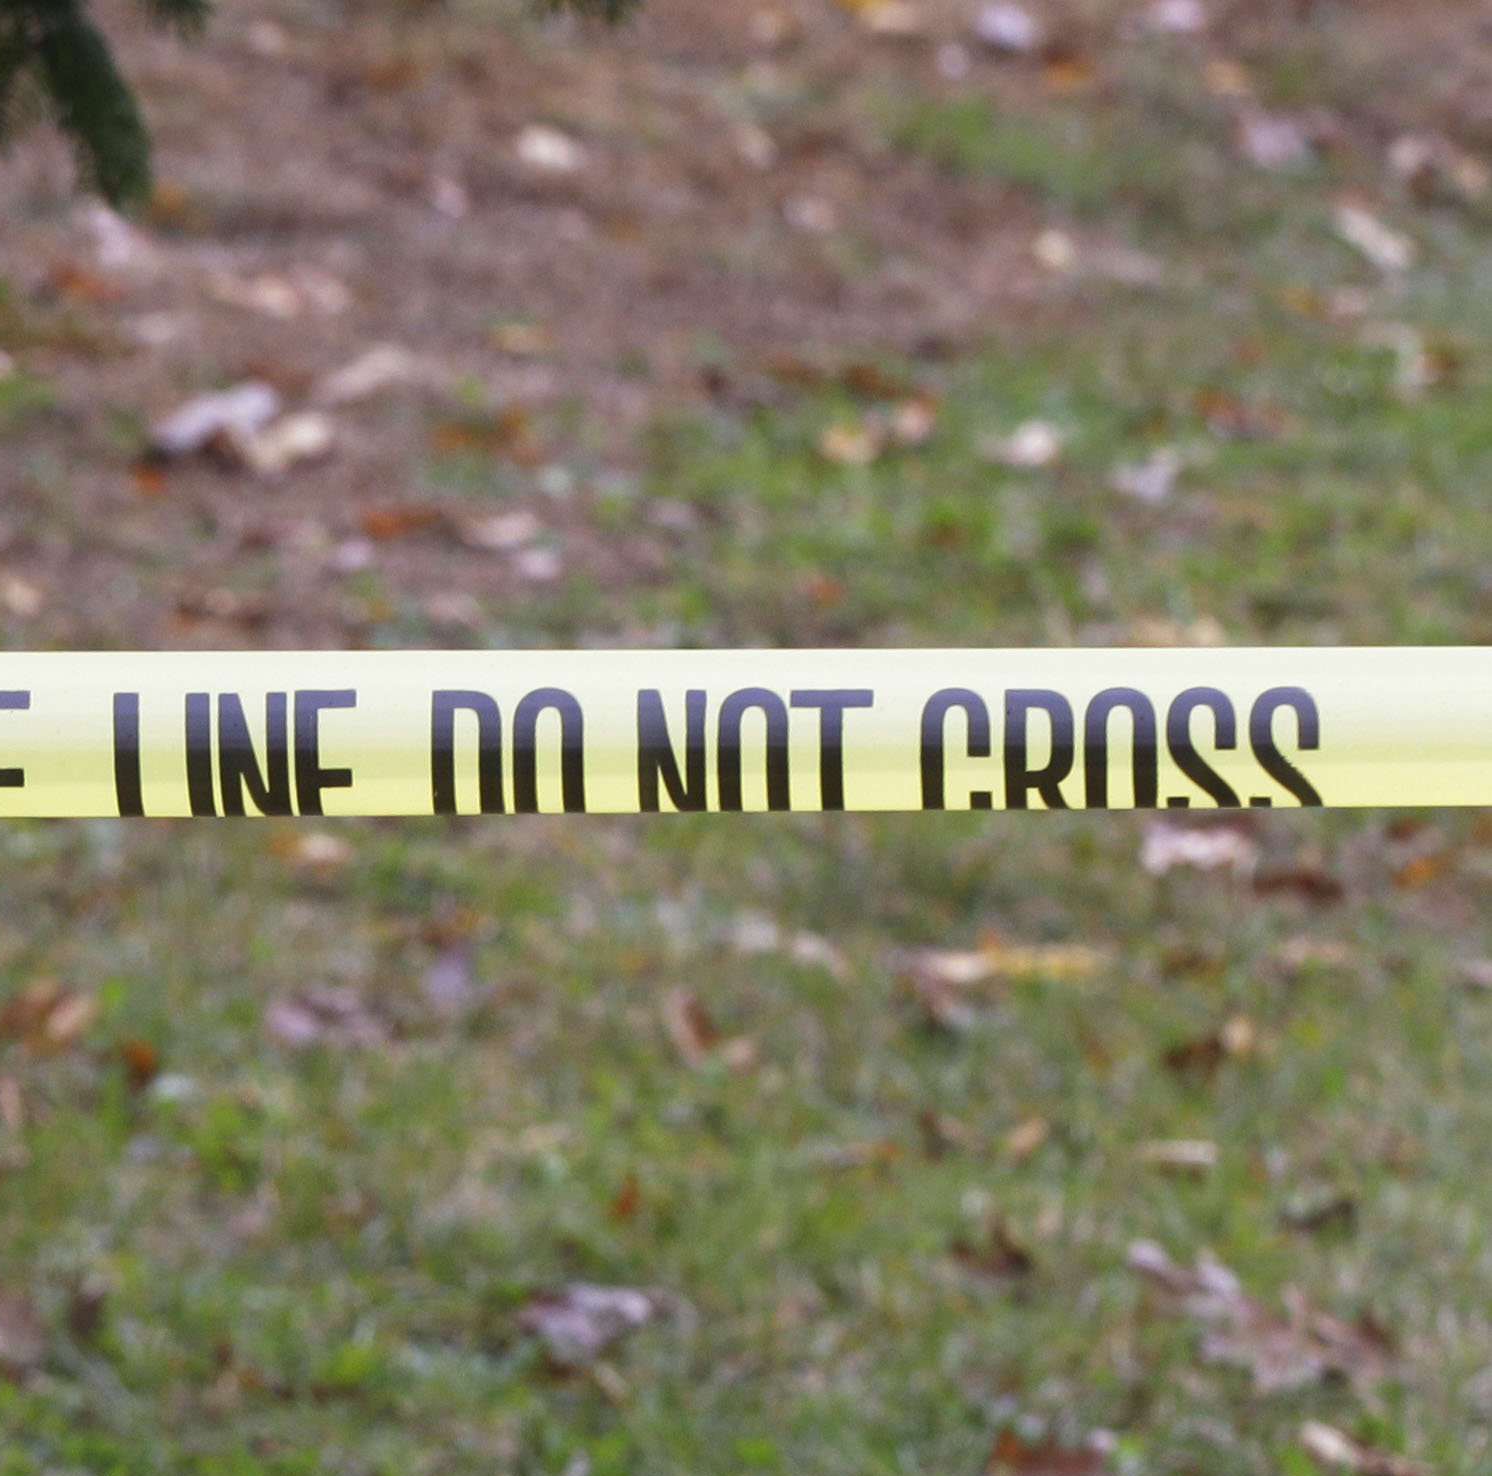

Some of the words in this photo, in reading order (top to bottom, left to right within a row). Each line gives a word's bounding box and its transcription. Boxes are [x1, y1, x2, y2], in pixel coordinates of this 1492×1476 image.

[112, 688, 358, 819] LINE
[430, 687, 585, 815] DO
[636, 687, 874, 813] NOT
[919, 685, 1323, 810] CROSS
